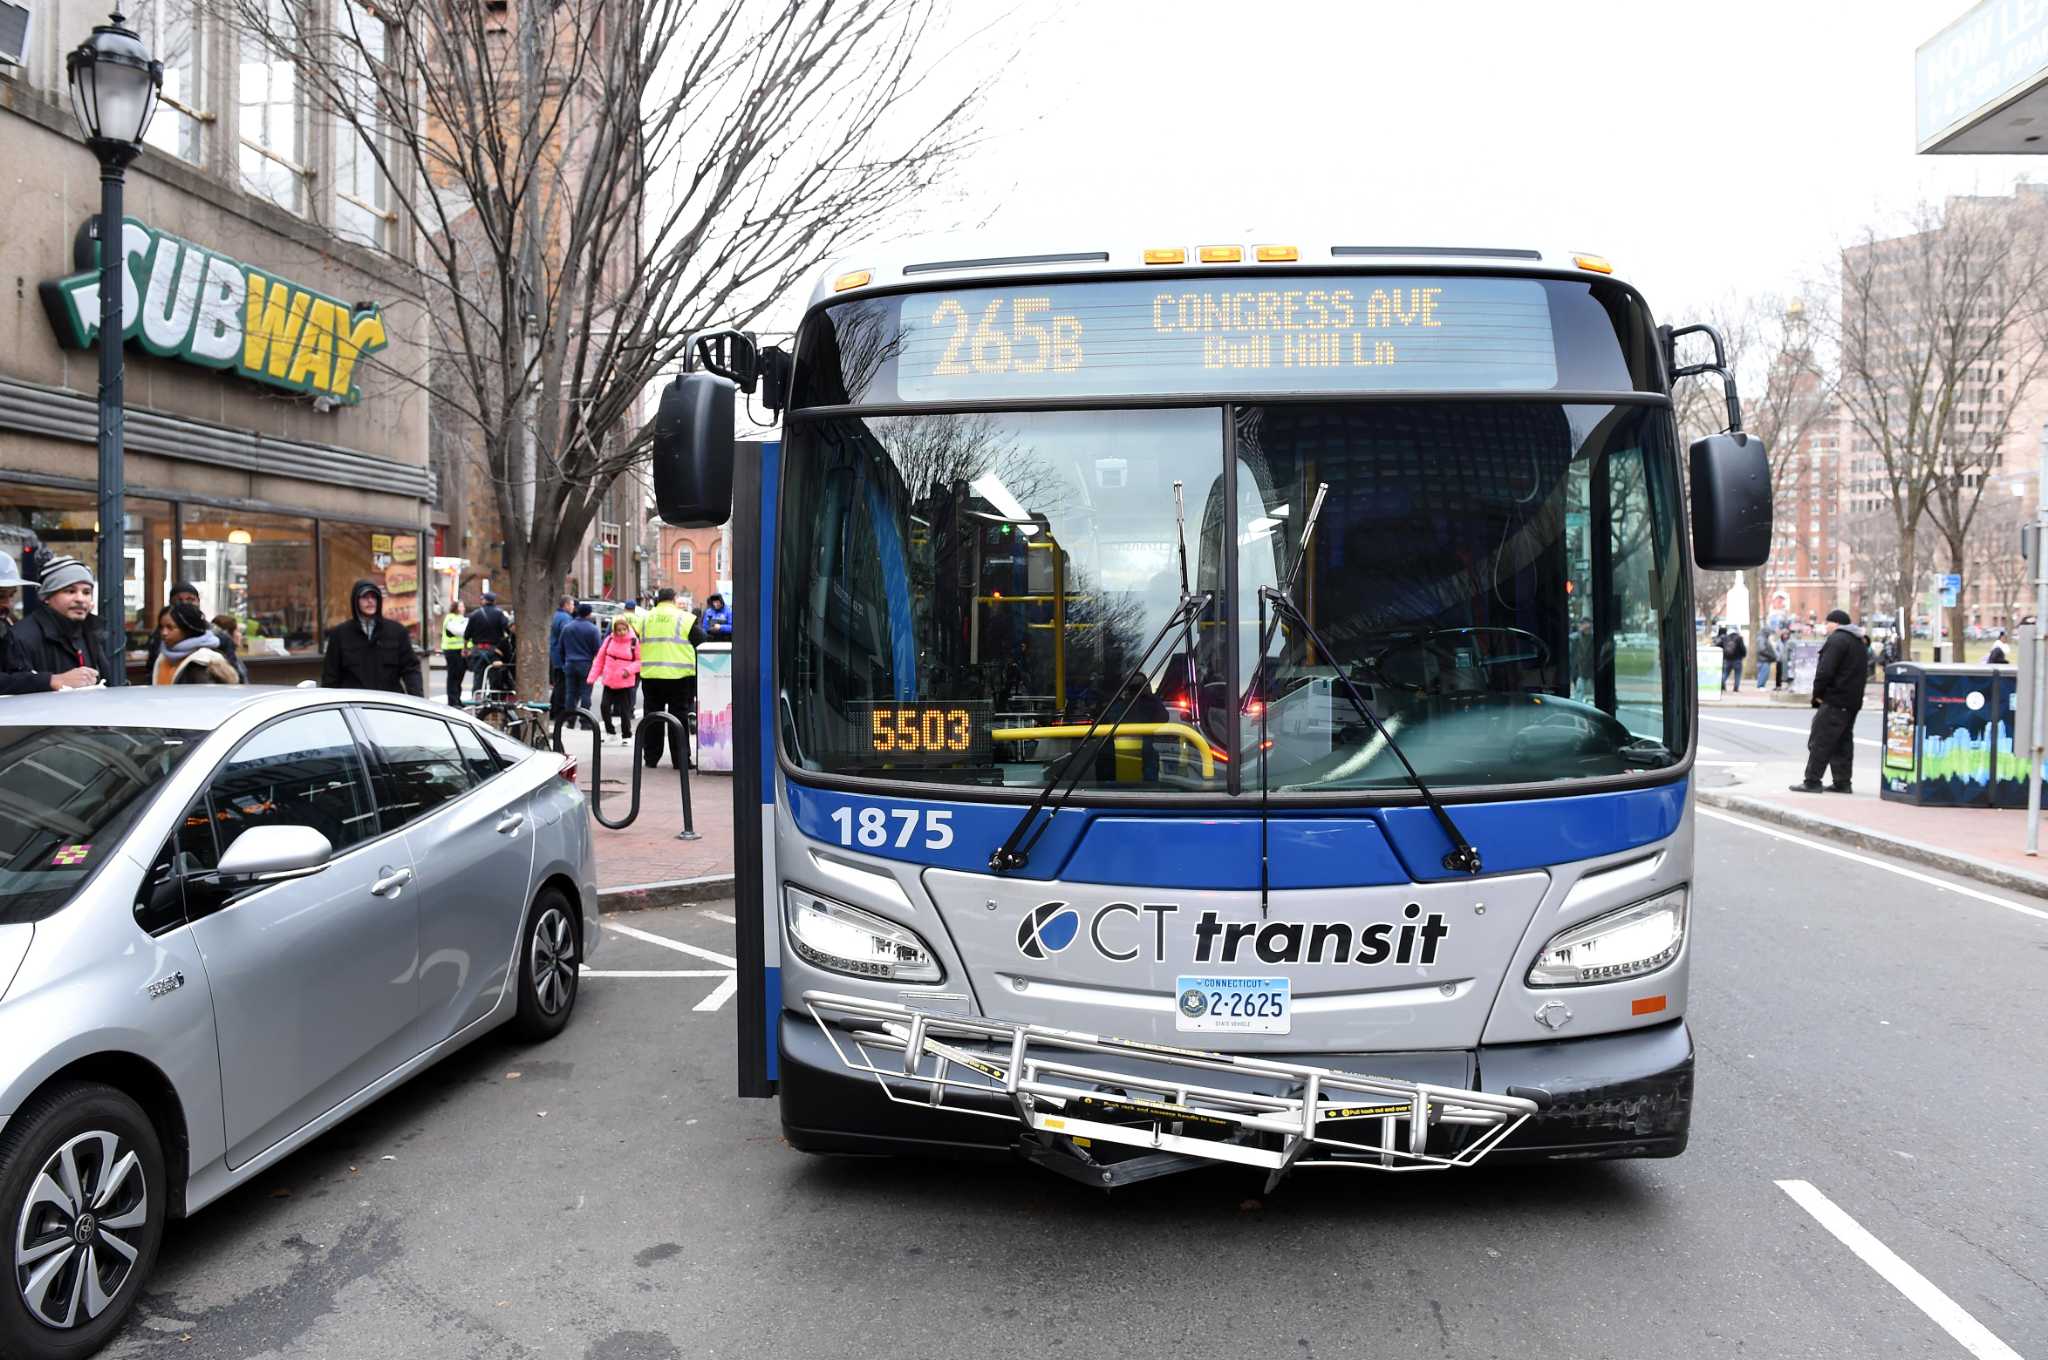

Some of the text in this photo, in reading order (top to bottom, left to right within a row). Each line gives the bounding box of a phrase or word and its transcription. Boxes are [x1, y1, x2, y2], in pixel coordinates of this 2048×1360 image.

[71, 223, 387, 396] SUBWAY
[1153, 288, 1443, 332] CONGRESS AVE
[1204, 332, 1395, 368] Bull Hill Ln
[872, 709, 970, 751] 5503
[831, 806, 954, 850] 1875
[1090, 902, 1448, 965] CT transit
[1204, 979, 1262, 988] CONNECTICUT
